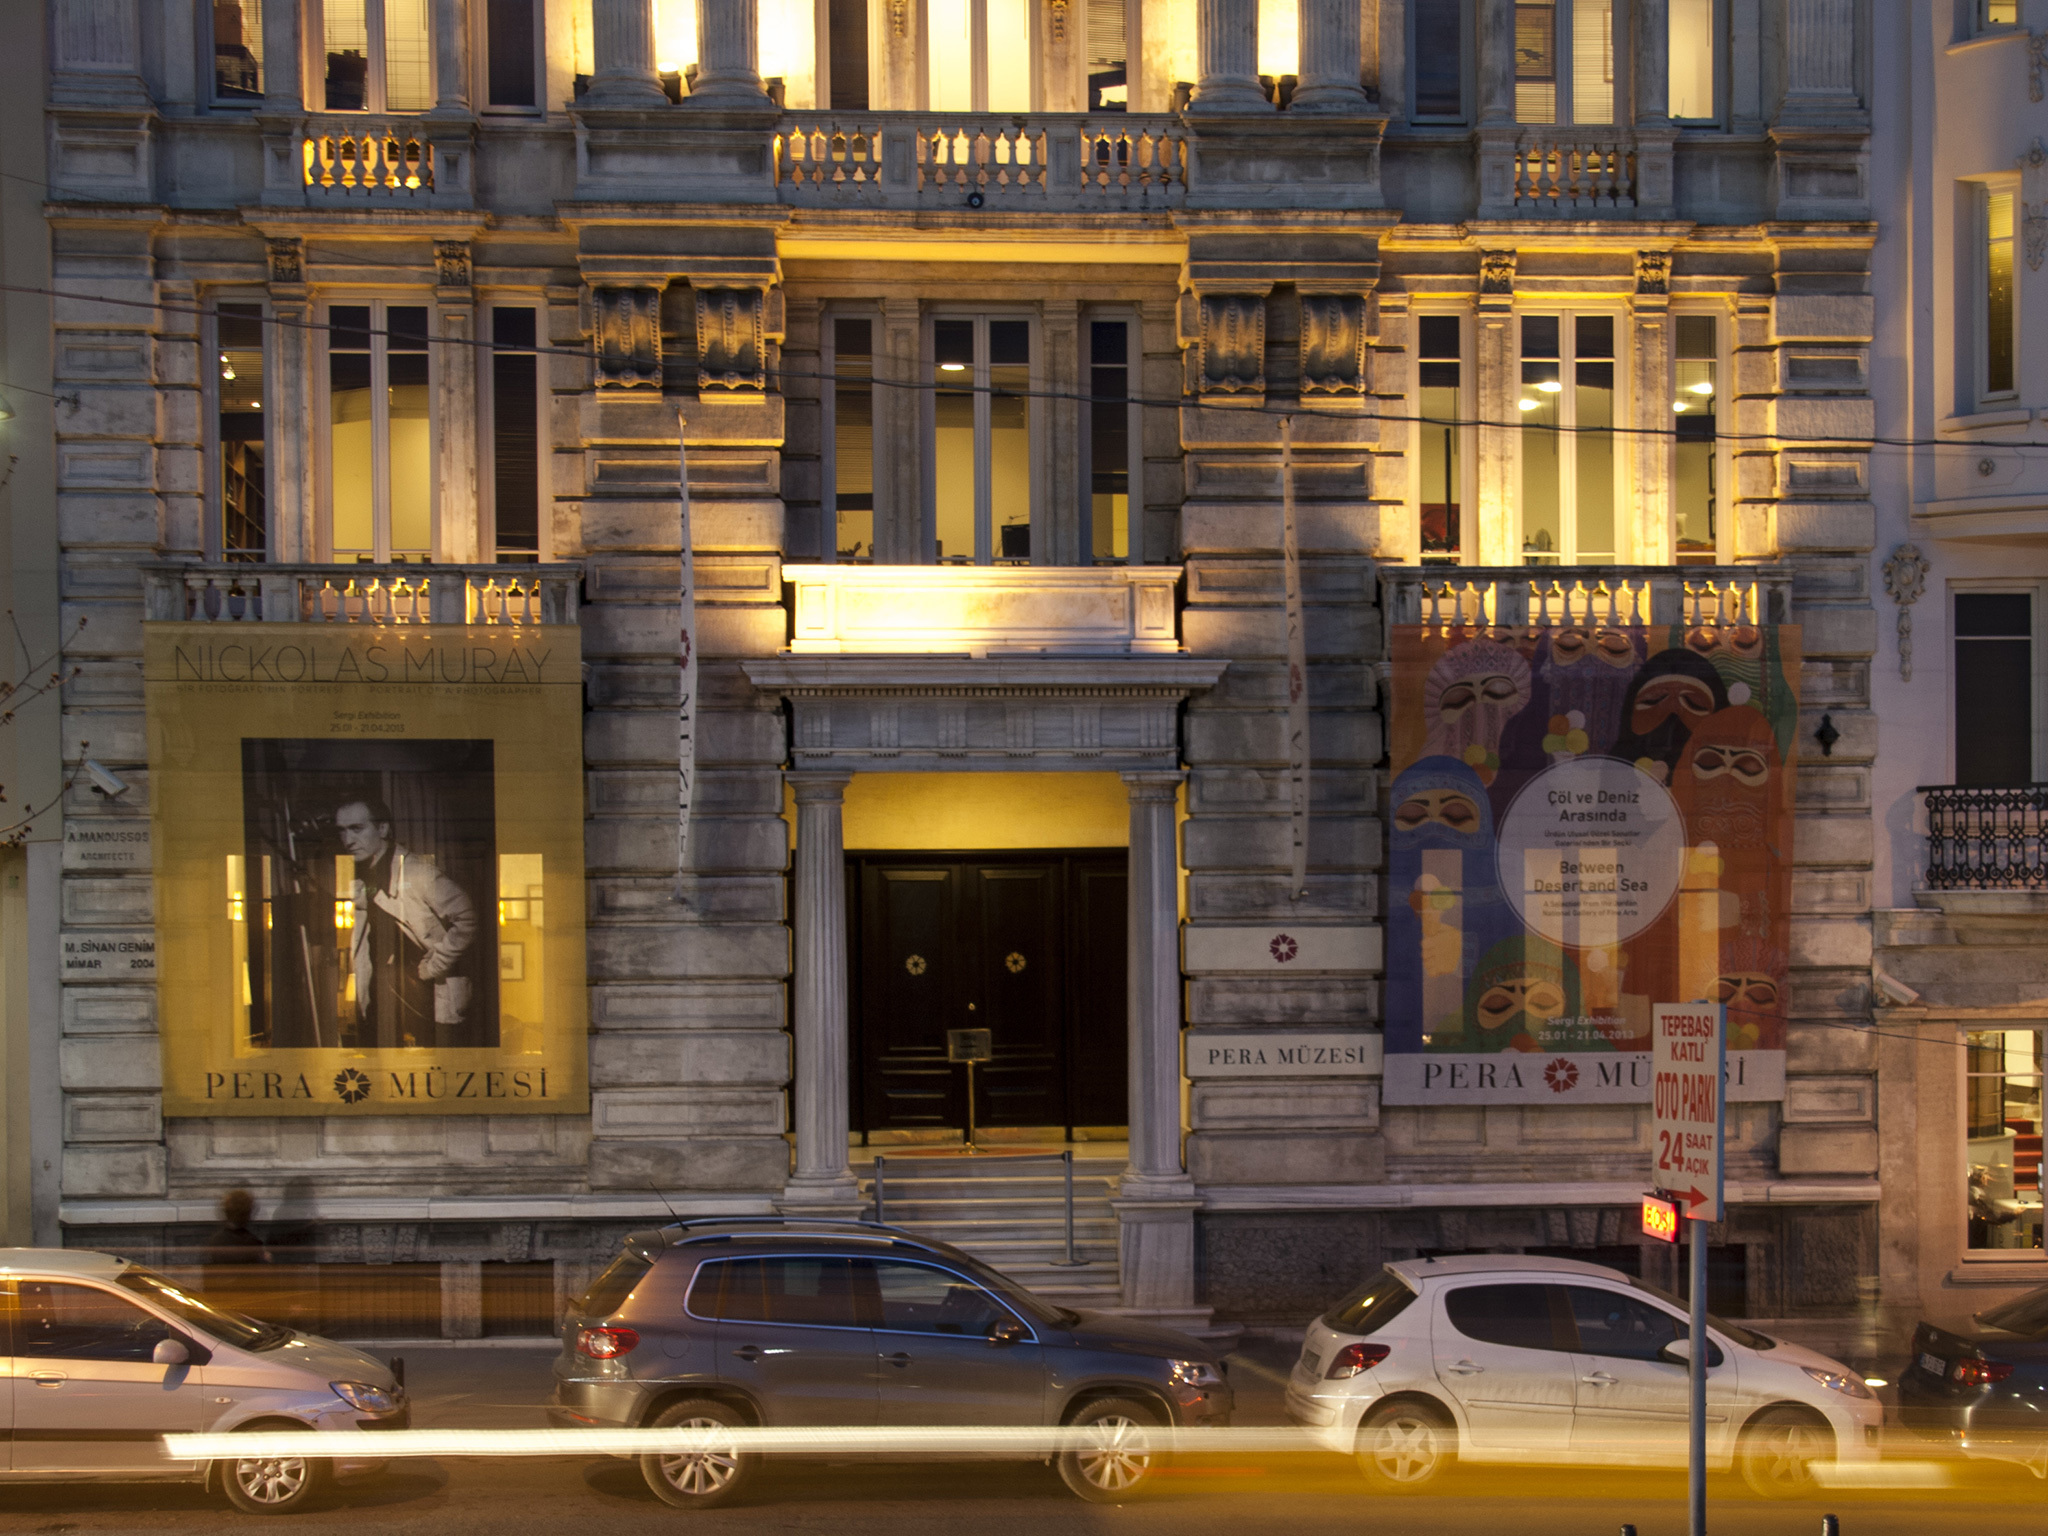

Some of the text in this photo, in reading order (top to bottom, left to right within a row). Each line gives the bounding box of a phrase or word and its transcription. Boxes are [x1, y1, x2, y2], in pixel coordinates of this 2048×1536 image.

[175, 645, 552, 684] NICKOLAS MURAY
[357, 711, 402, 720] Exhibition
[1548, 790, 1640, 806] Çöl ve Deniz
[1559, 809, 1627, 822] Arasında
[1560, 861, 1624, 874] Between
[1534, 879, 1648, 893] Desert and Sea
[1622, 909, 1638, 917] Arts
[81, 939, 116, 953] SİNAN
[118, 939, 155, 953] GENİM
[66, 957, 155, 969] MİMAR 2004
[1547, 1015, 1627, 1027] Sergi Exhibition
[1661, 1015, 1714, 1042] TEPEBAŞI
[1538, 1030, 1567, 1040] 25.01
[1576, 1030, 1634, 1040] 21.04.2013
[1208, 1045, 1365, 1065] PERA MÜZESİ
[1671, 1041, 1704, 1062] KATLI
[205, 1066, 550, 1099] PERA MÜZESİ
[1422, 1062, 1525, 1090] PERA
[1655, 1071, 1716, 1124] OTO PARKI
[1685, 1132, 1713, 1151] SAAT
[1658, 1129, 1684, 1172] 24
[1685, 1157, 1709, 1177] AÇIK
